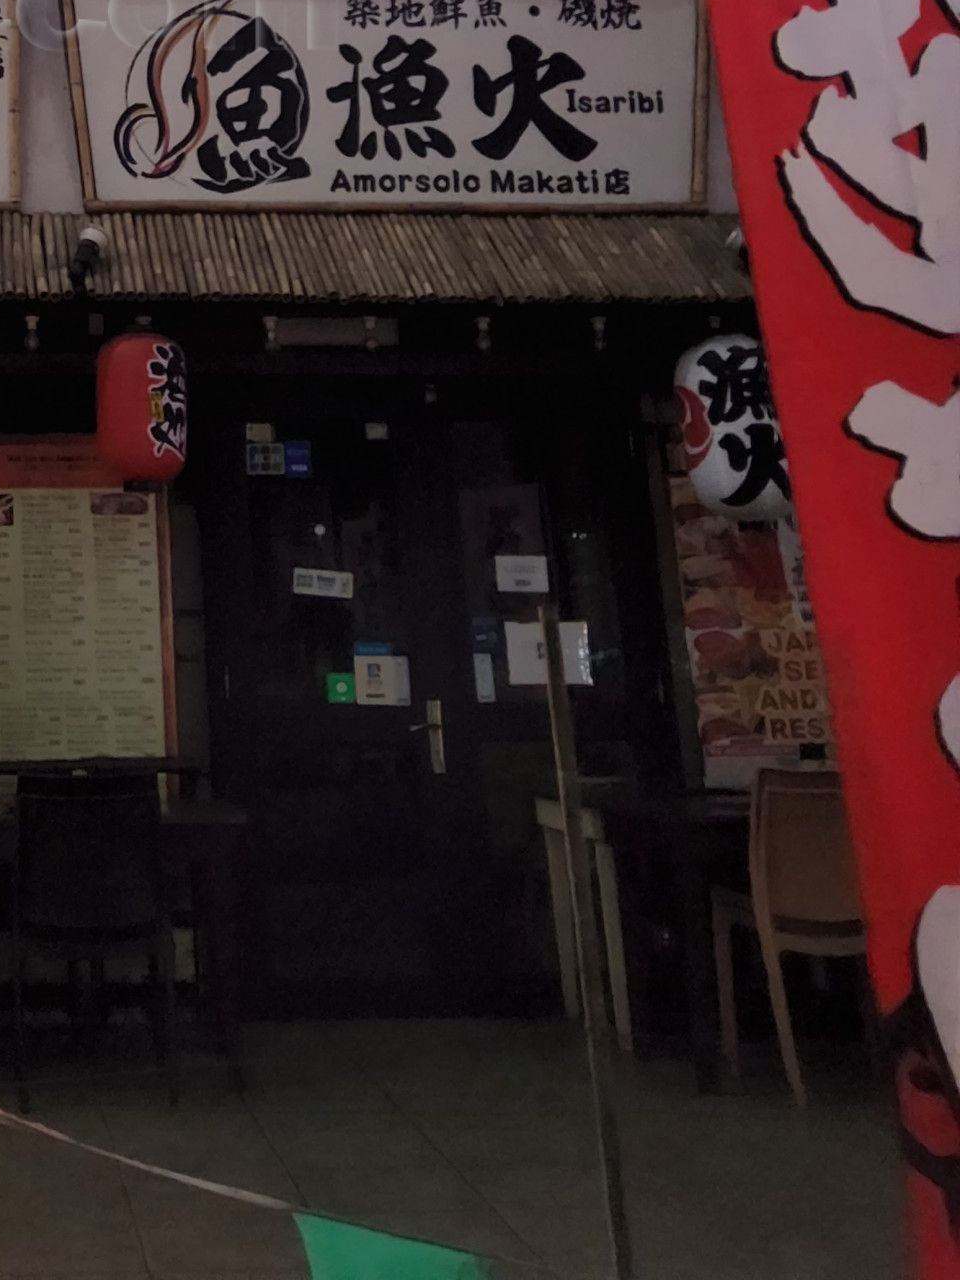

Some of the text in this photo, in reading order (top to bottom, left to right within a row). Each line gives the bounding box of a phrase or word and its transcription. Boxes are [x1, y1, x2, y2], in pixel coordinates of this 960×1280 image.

[326, 34, 598, 162] 漁火
[566, 87, 663, 116] Isaribi
[330, 168, 481, 196] Amorsolo
[698, 345, 790, 508] 漁火
[760, 688, 818, 710] AND
